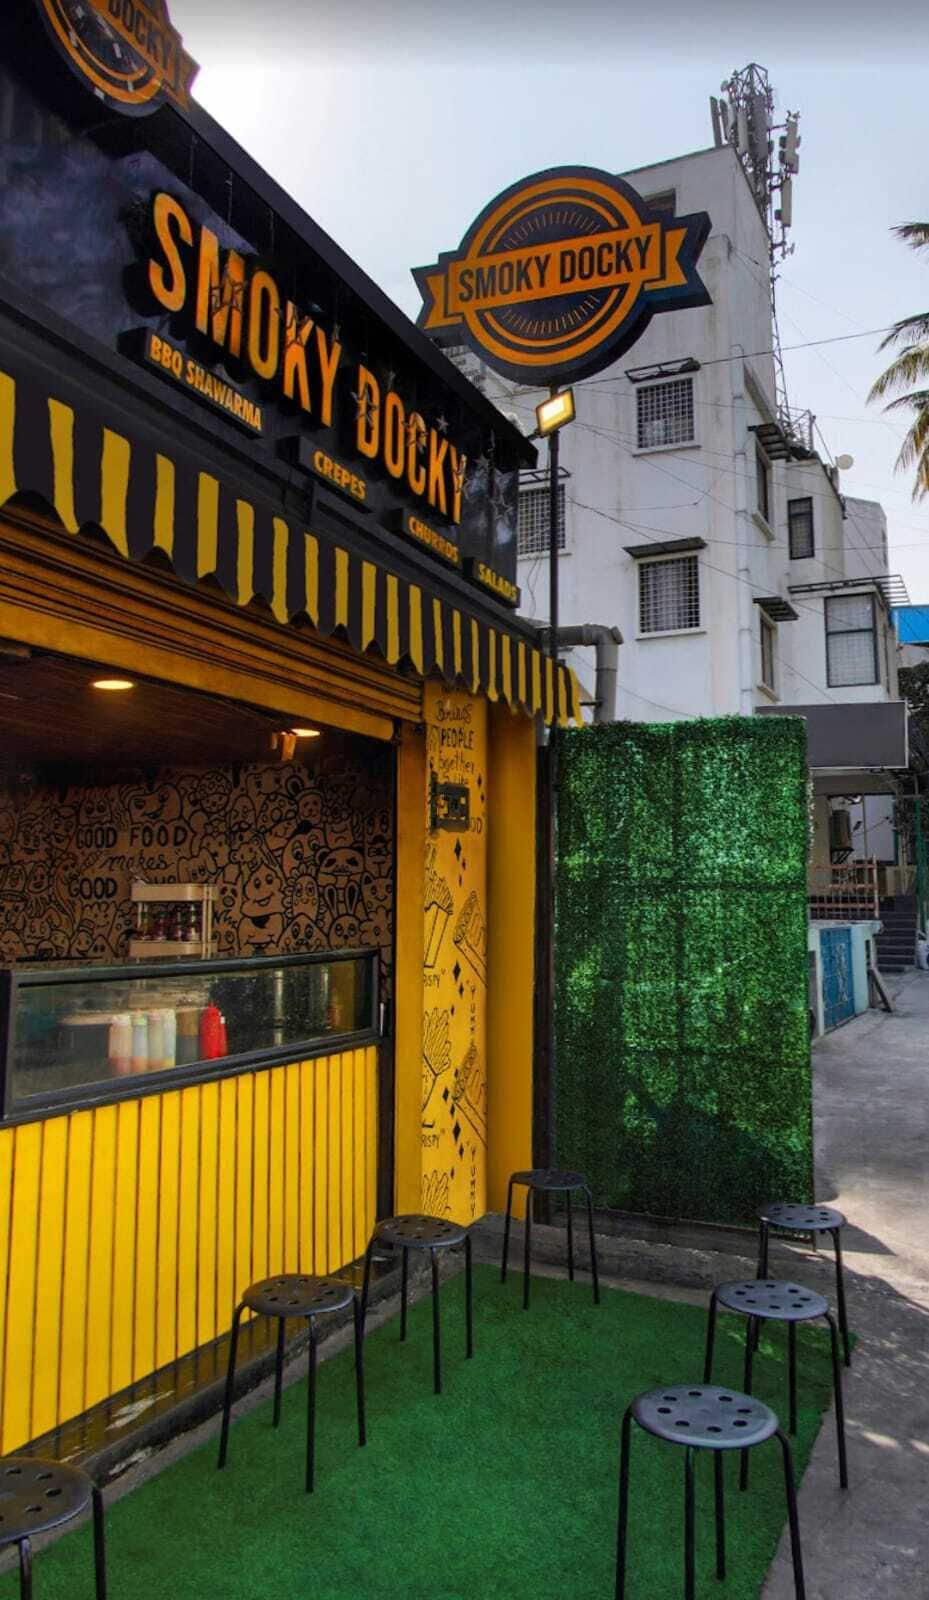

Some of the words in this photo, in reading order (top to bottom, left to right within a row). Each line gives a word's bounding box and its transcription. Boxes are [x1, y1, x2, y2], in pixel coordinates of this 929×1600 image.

[458, 252, 553, 302] SMOKY
[559, 234, 653, 284] DOCKY
[148, 192, 343, 429] SMOKY
[356, 364, 467, 525] DOCKY
[150, 334, 182, 380] BBQ
[186, 359, 262, 432] SHAWARMA
[313, 450, 367, 500] CREPES
[408, 516, 460, 563] CHURROS
[478, 563, 518, 602] SALADS
[440, 727, 475, 750] PEOPLE
[75, 825, 118, 849] GOOD
[130, 825, 188, 848] FOOD
[68, 877, 118, 900] GOOD
